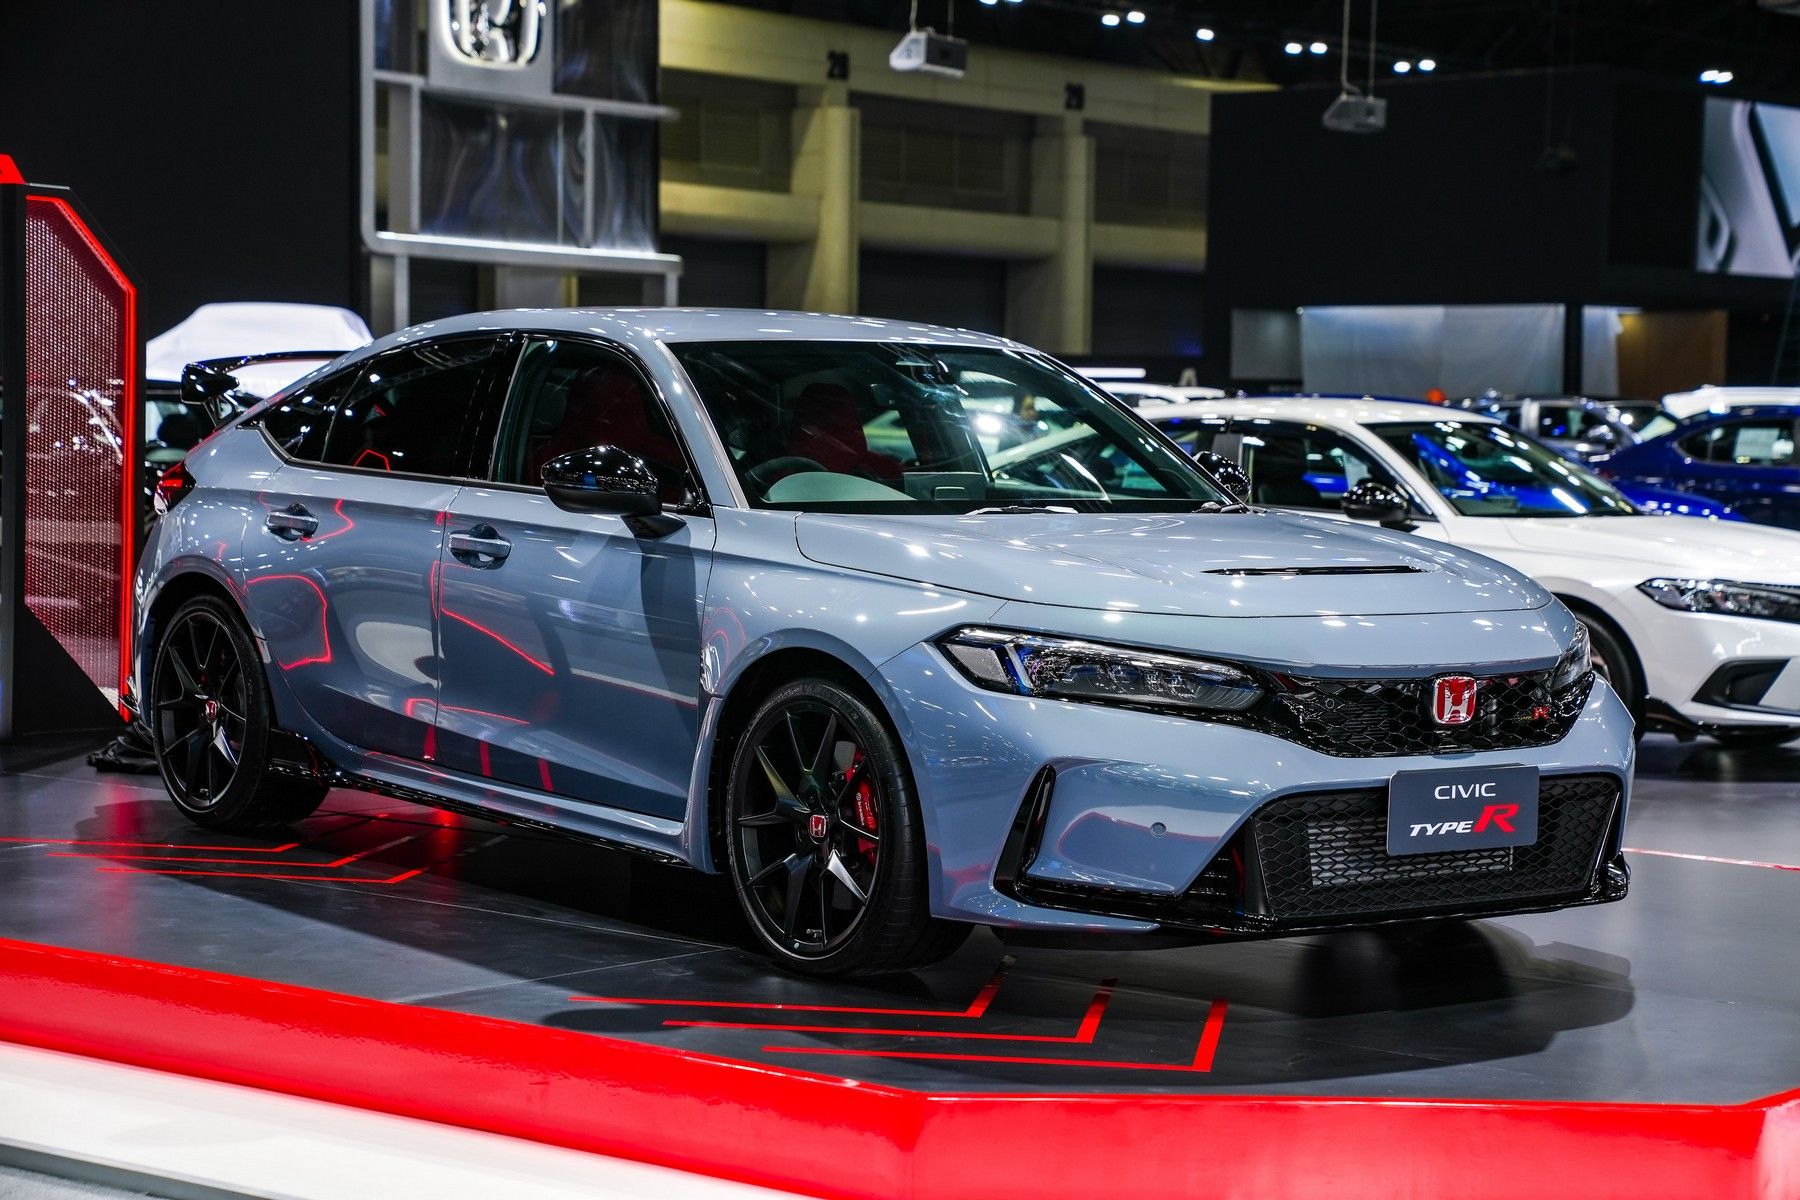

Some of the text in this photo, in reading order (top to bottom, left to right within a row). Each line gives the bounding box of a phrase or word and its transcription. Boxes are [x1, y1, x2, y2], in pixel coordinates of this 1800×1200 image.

[1434, 782, 1496, 800] CIVIC
[1409, 803, 1520, 837] TYPE R
